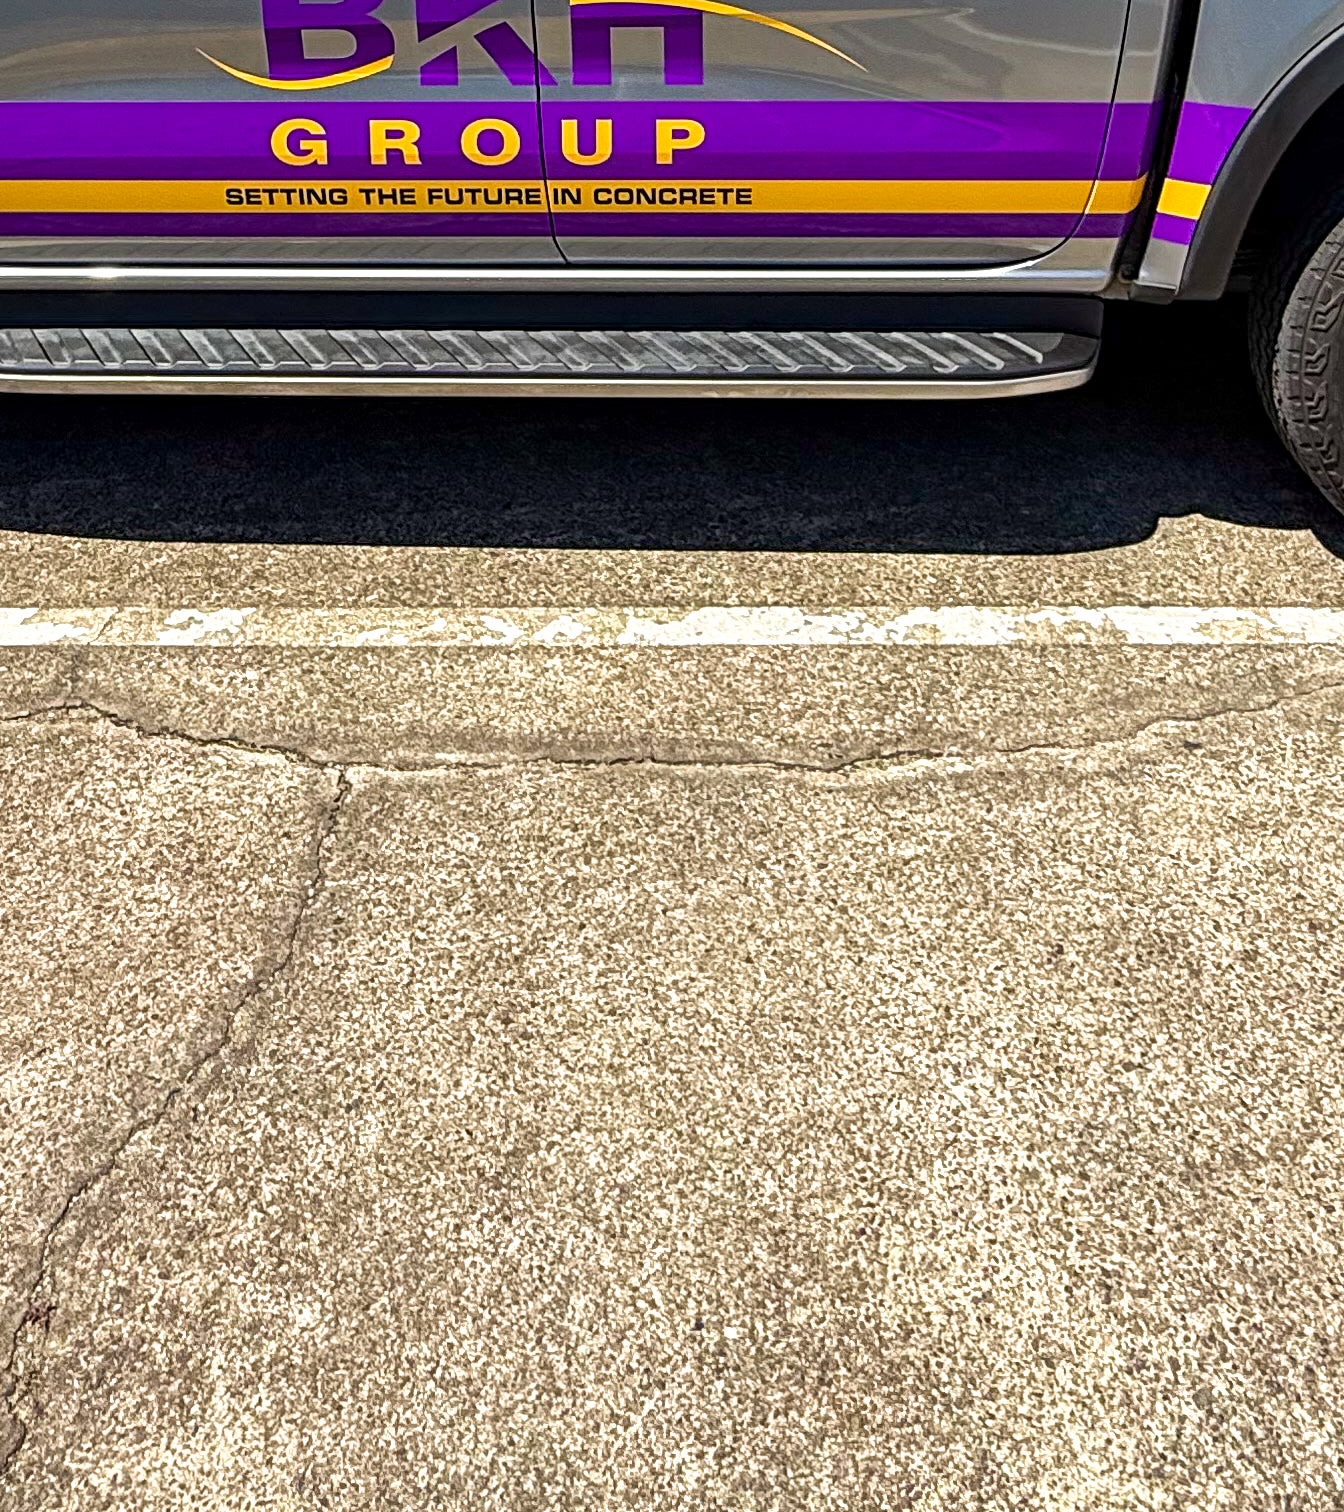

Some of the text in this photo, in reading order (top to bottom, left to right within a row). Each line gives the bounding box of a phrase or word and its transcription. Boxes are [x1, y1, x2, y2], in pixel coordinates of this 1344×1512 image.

[269, 117, 706, 167] GROUP
[225, 187, 753, 206] SETTING THE FUTURE IN CONCRETE
